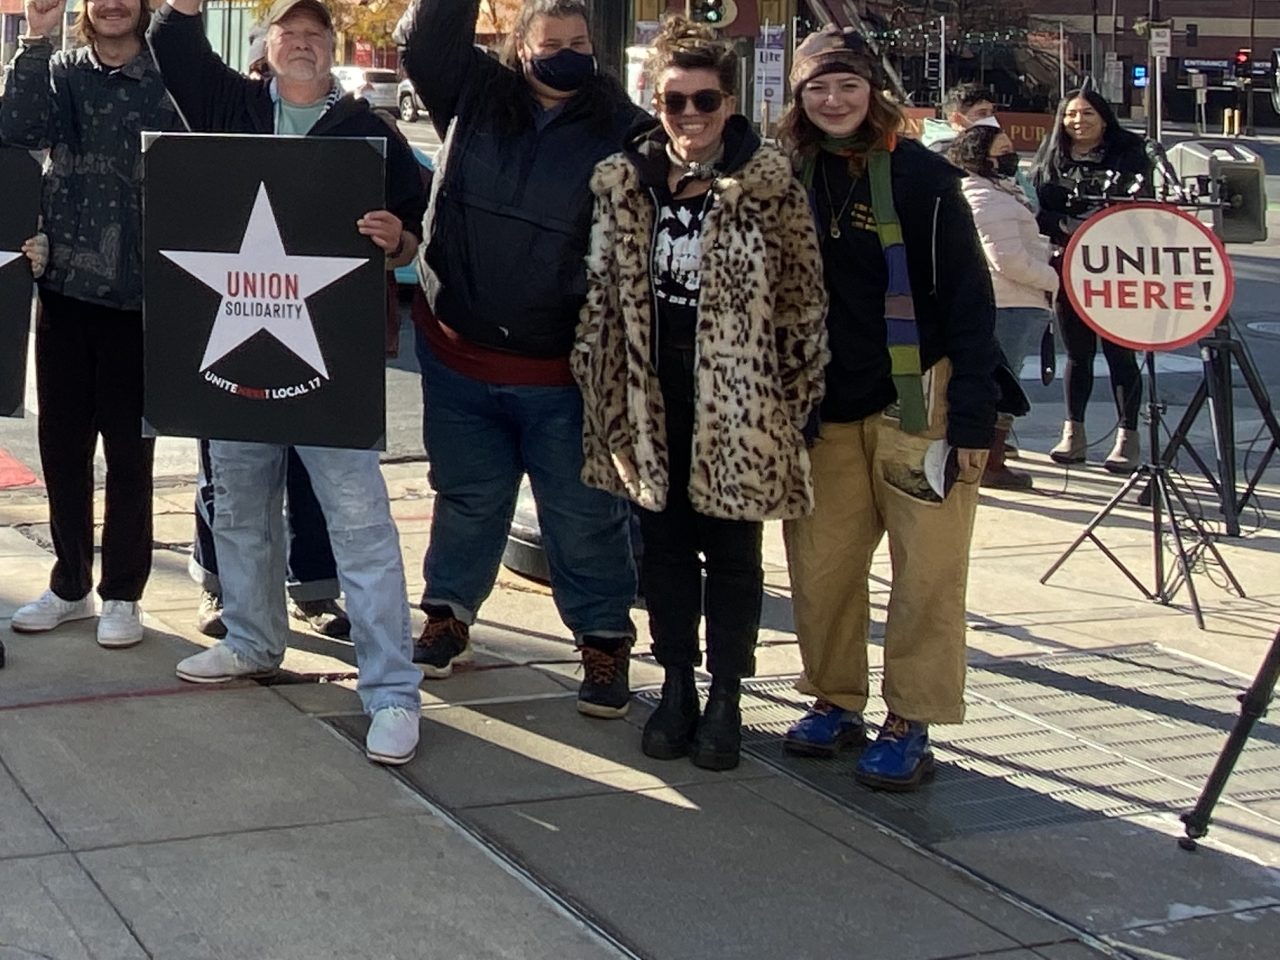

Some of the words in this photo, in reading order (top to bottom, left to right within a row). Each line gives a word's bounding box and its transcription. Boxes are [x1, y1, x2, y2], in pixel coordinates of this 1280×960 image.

[1183, 59, 1229, 68] ENTRANCE
[1081, 245, 1214, 276] UNITE
[227, 271, 298, 300] UNION
[1083, 279, 1211, 312] HERE!
[225, 301, 303, 320] SOLIDARITY
[272, 383, 308, 399] LOCAL
[308, 376, 321, 388] 17
